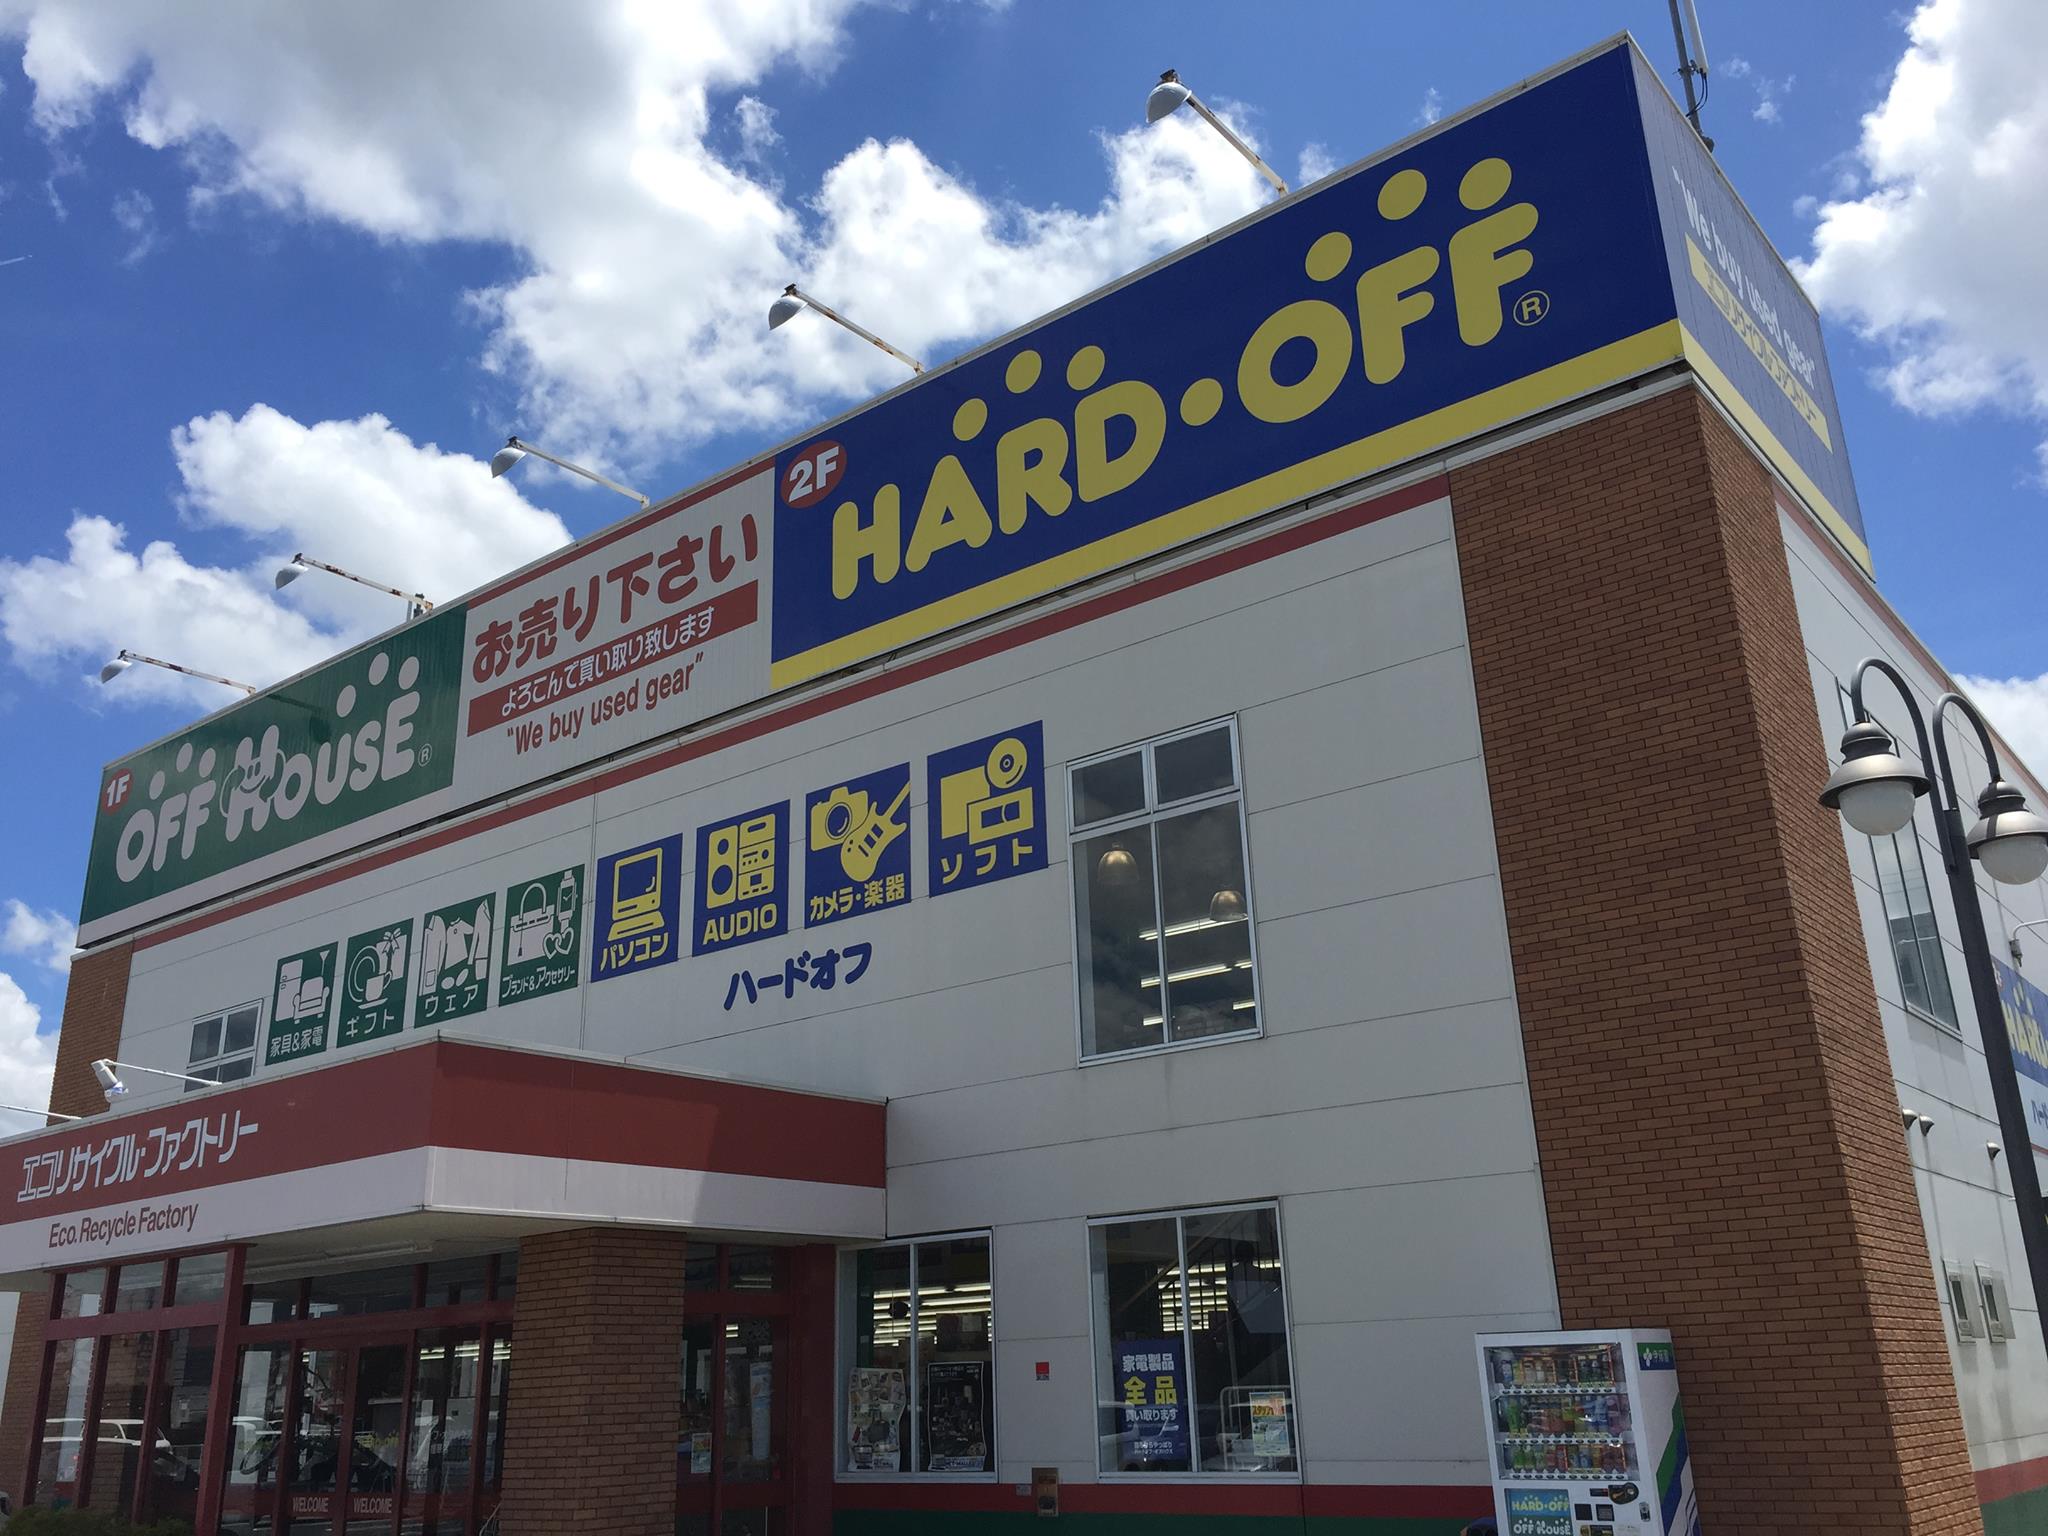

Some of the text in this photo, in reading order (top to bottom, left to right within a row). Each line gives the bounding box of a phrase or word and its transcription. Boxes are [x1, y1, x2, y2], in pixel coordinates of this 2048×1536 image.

[1711, 222, 1744, 300] buy
[1745, 275, 1784, 348] used
[786, 443, 842, 504] 2F
[472, 513, 758, 684] お売り下さい
[502, 606, 715, 716] よろこんで買い取り致します
[550, 706, 584, 742] buy
[591, 678, 640, 725] used
[106, 774, 131, 807] 1F
[116, 780, 217, 882] OFF
[225, 691, 421, 842] HOUSE
[940, 838, 1034, 885] ソフト
[810, 872, 906, 921] カメラ・楽器
[702, 903, 778, 946] AUDIO
[599, 932, 669, 972] パソコン
[723, 942, 873, 1011] ハードオフ
[425, 984, 478, 1018] ウェア
[270, 1025, 324, 1057] 家具&家電
[346, 1008, 395, 1039] ギフト
[138, 1203, 199, 1234] Factory
[1122, 1353, 1175, 1373] 家電製品
[1123, 1375, 1178, 1405] 全品
[292, 1496, 329, 1513] WELCOME
[353, 1497, 393, 1514] WELCOME
